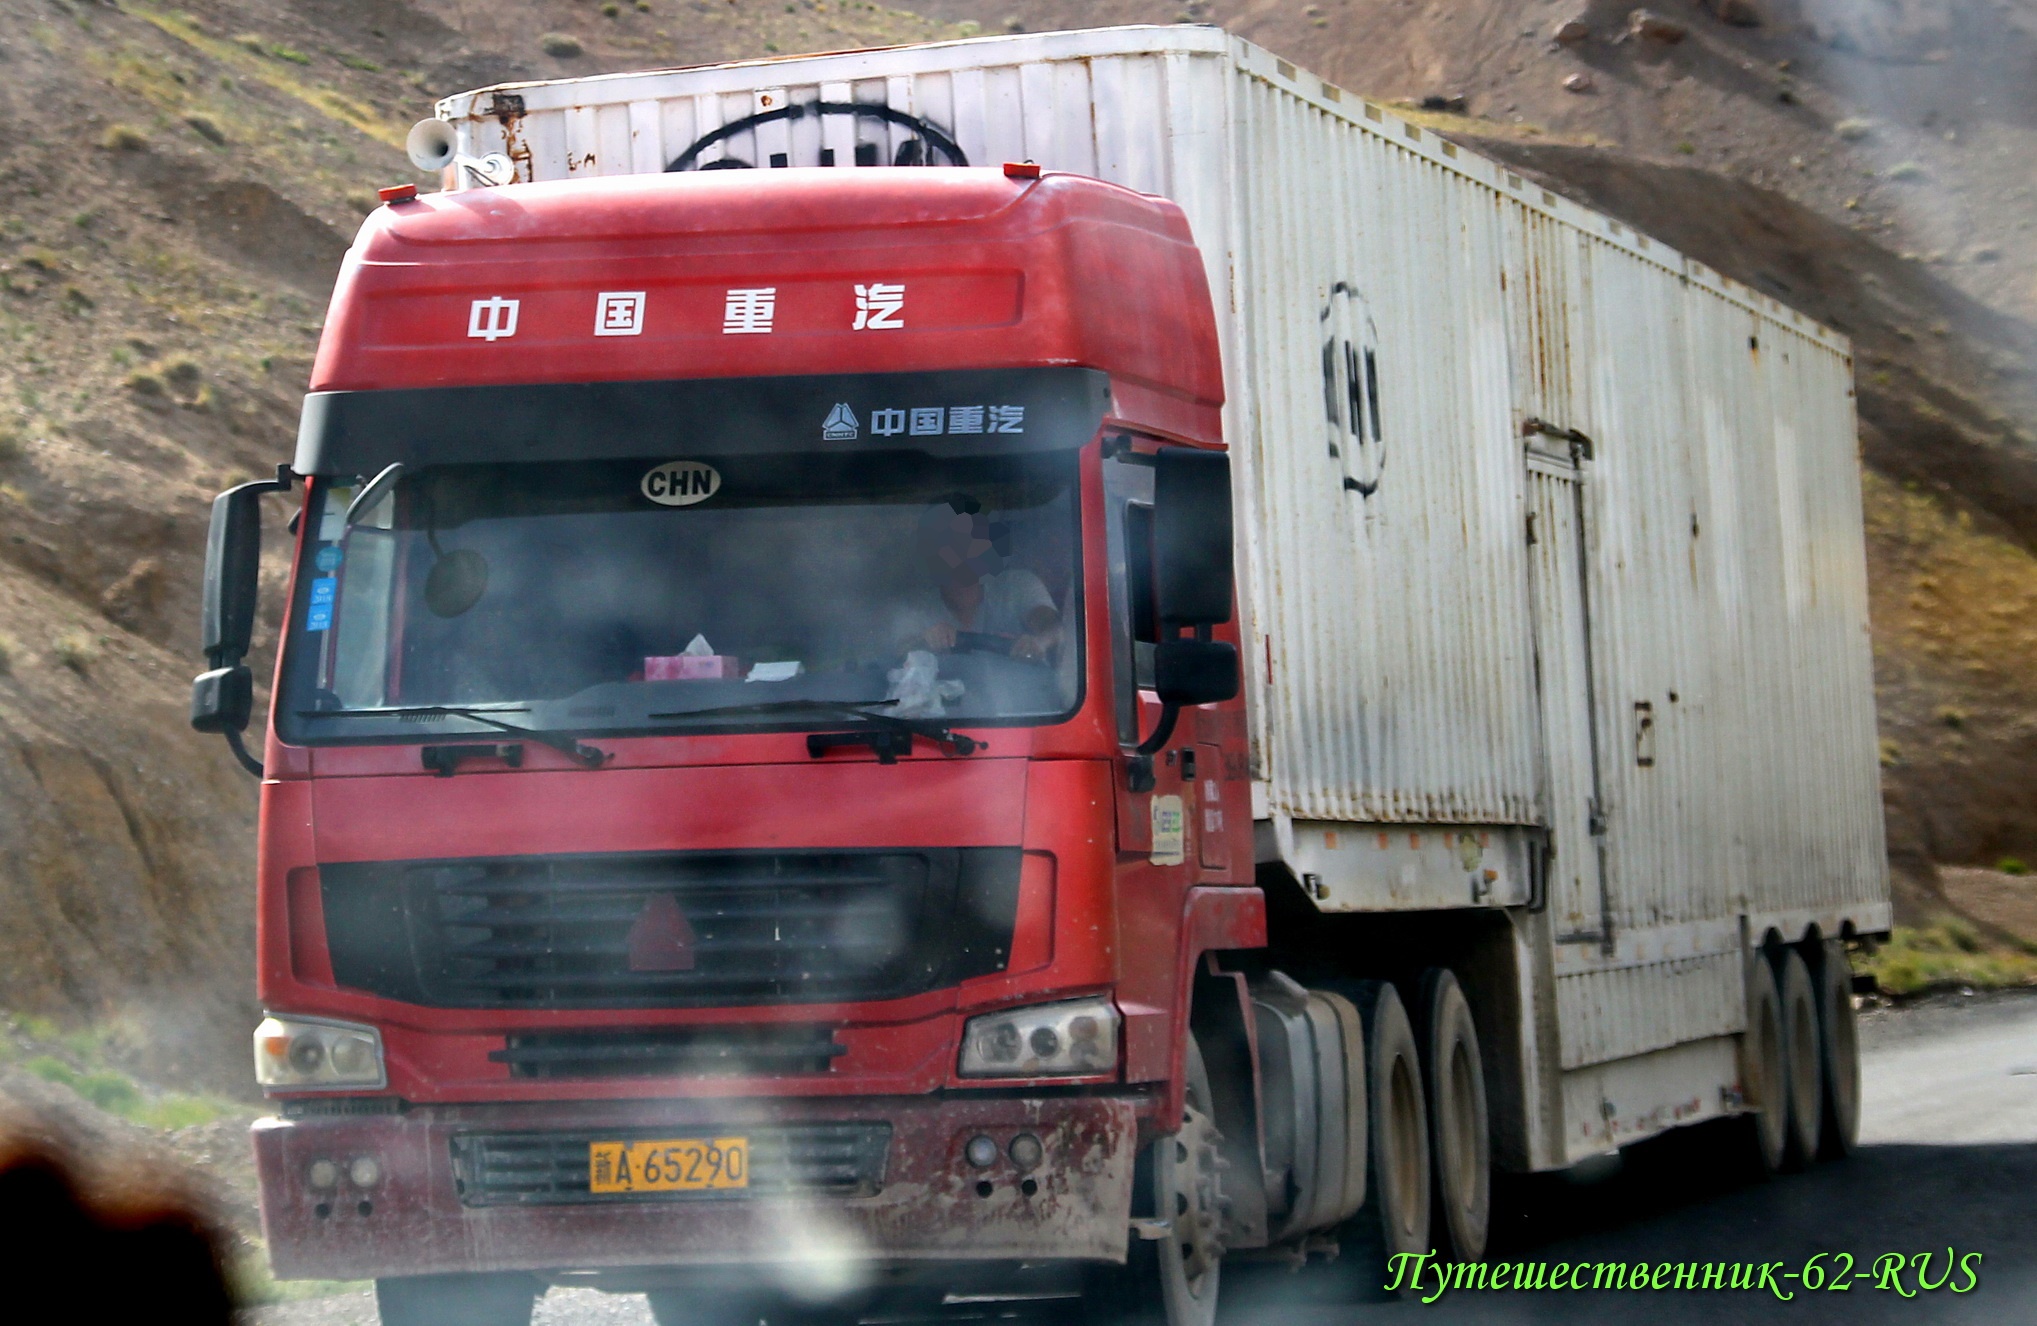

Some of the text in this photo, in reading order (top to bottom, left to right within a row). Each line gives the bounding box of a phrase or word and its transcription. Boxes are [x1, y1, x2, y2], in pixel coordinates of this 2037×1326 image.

[467, 283, 905, 342] 中国重汽
[871, 405, 1024, 436] 中国重汽
[648, 470, 711, 496] CHN
